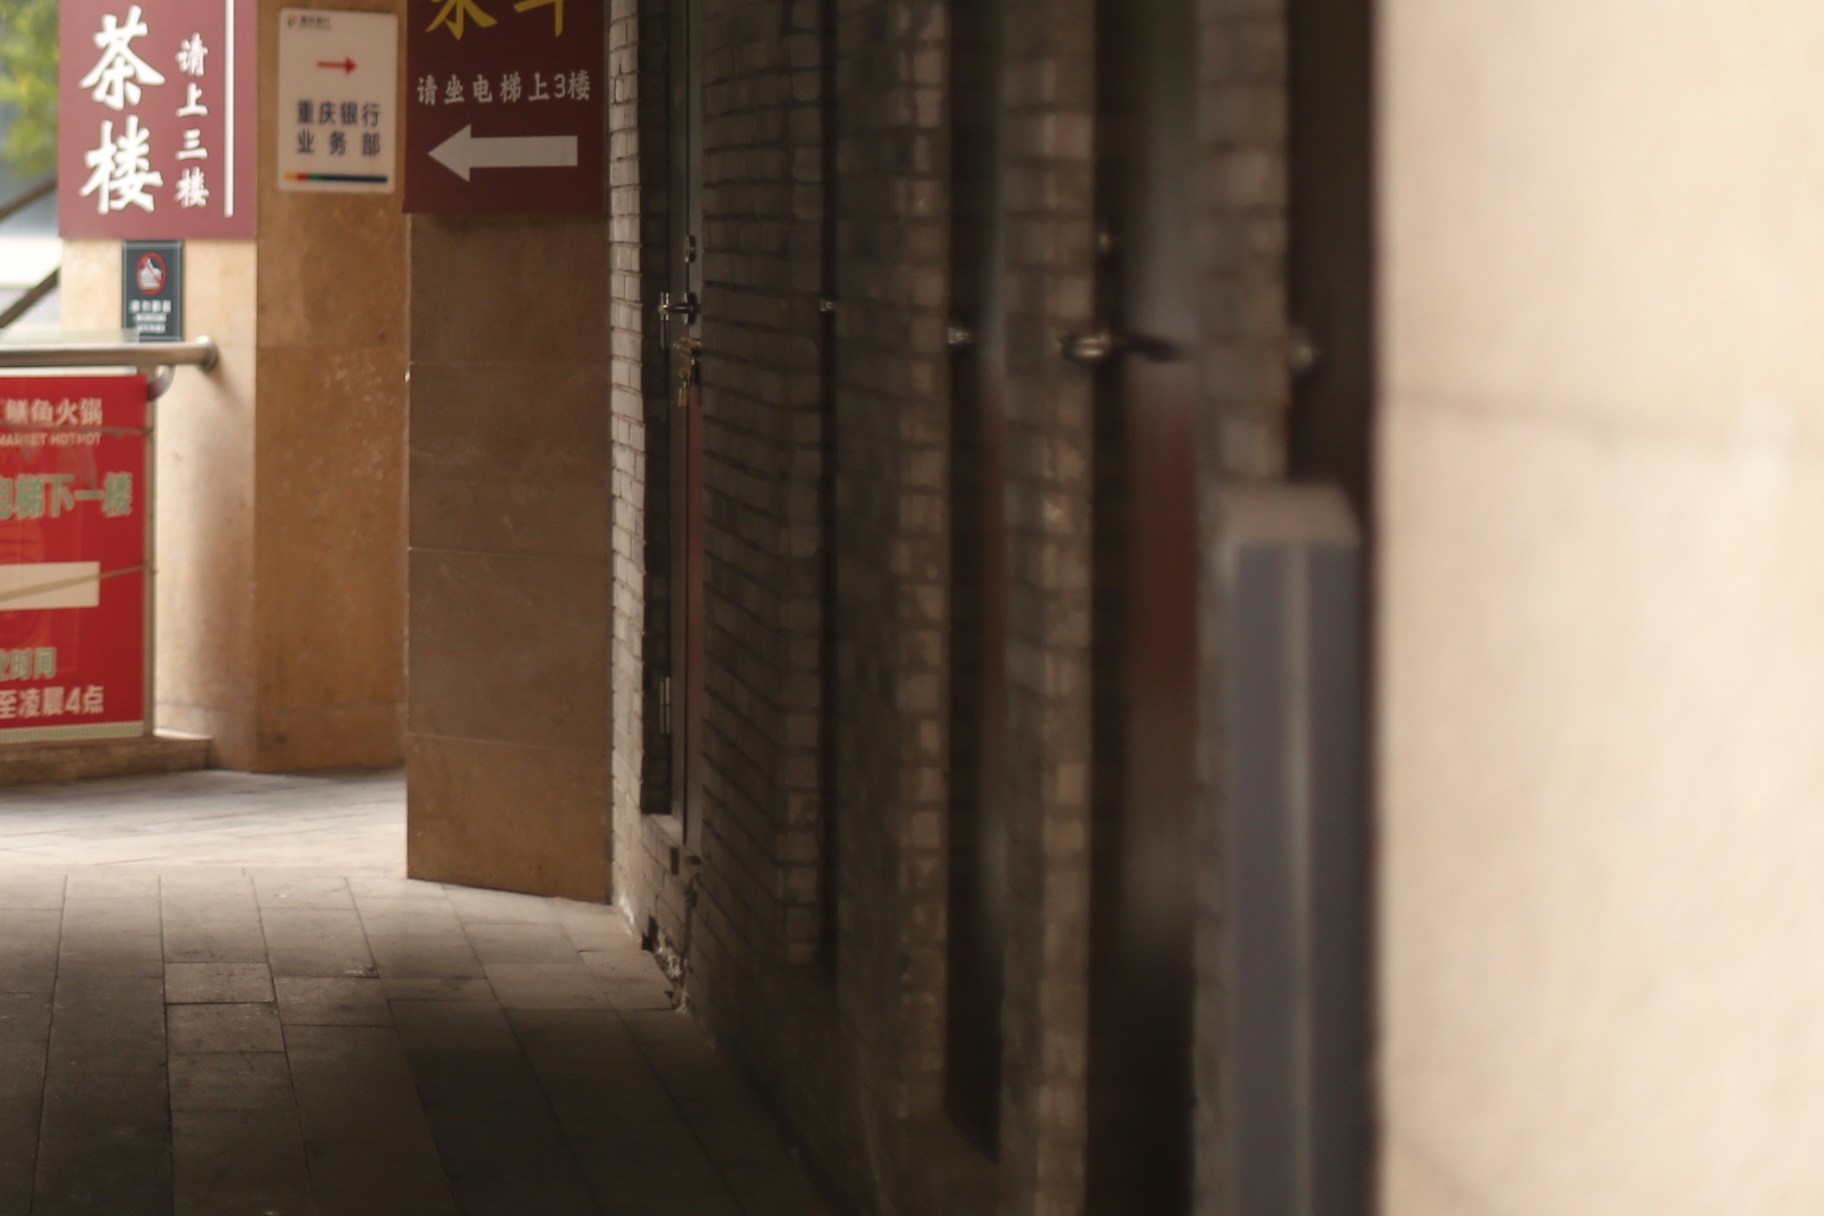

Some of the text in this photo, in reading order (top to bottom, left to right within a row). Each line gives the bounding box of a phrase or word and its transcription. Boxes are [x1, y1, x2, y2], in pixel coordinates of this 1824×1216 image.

[417, 70, 591, 106] 请坐电梯上3楼
[176, 33, 209, 208] 请上三楼
[297, 100, 381, 127] 重庆银行
[297, 130, 381, 157] 业务部
